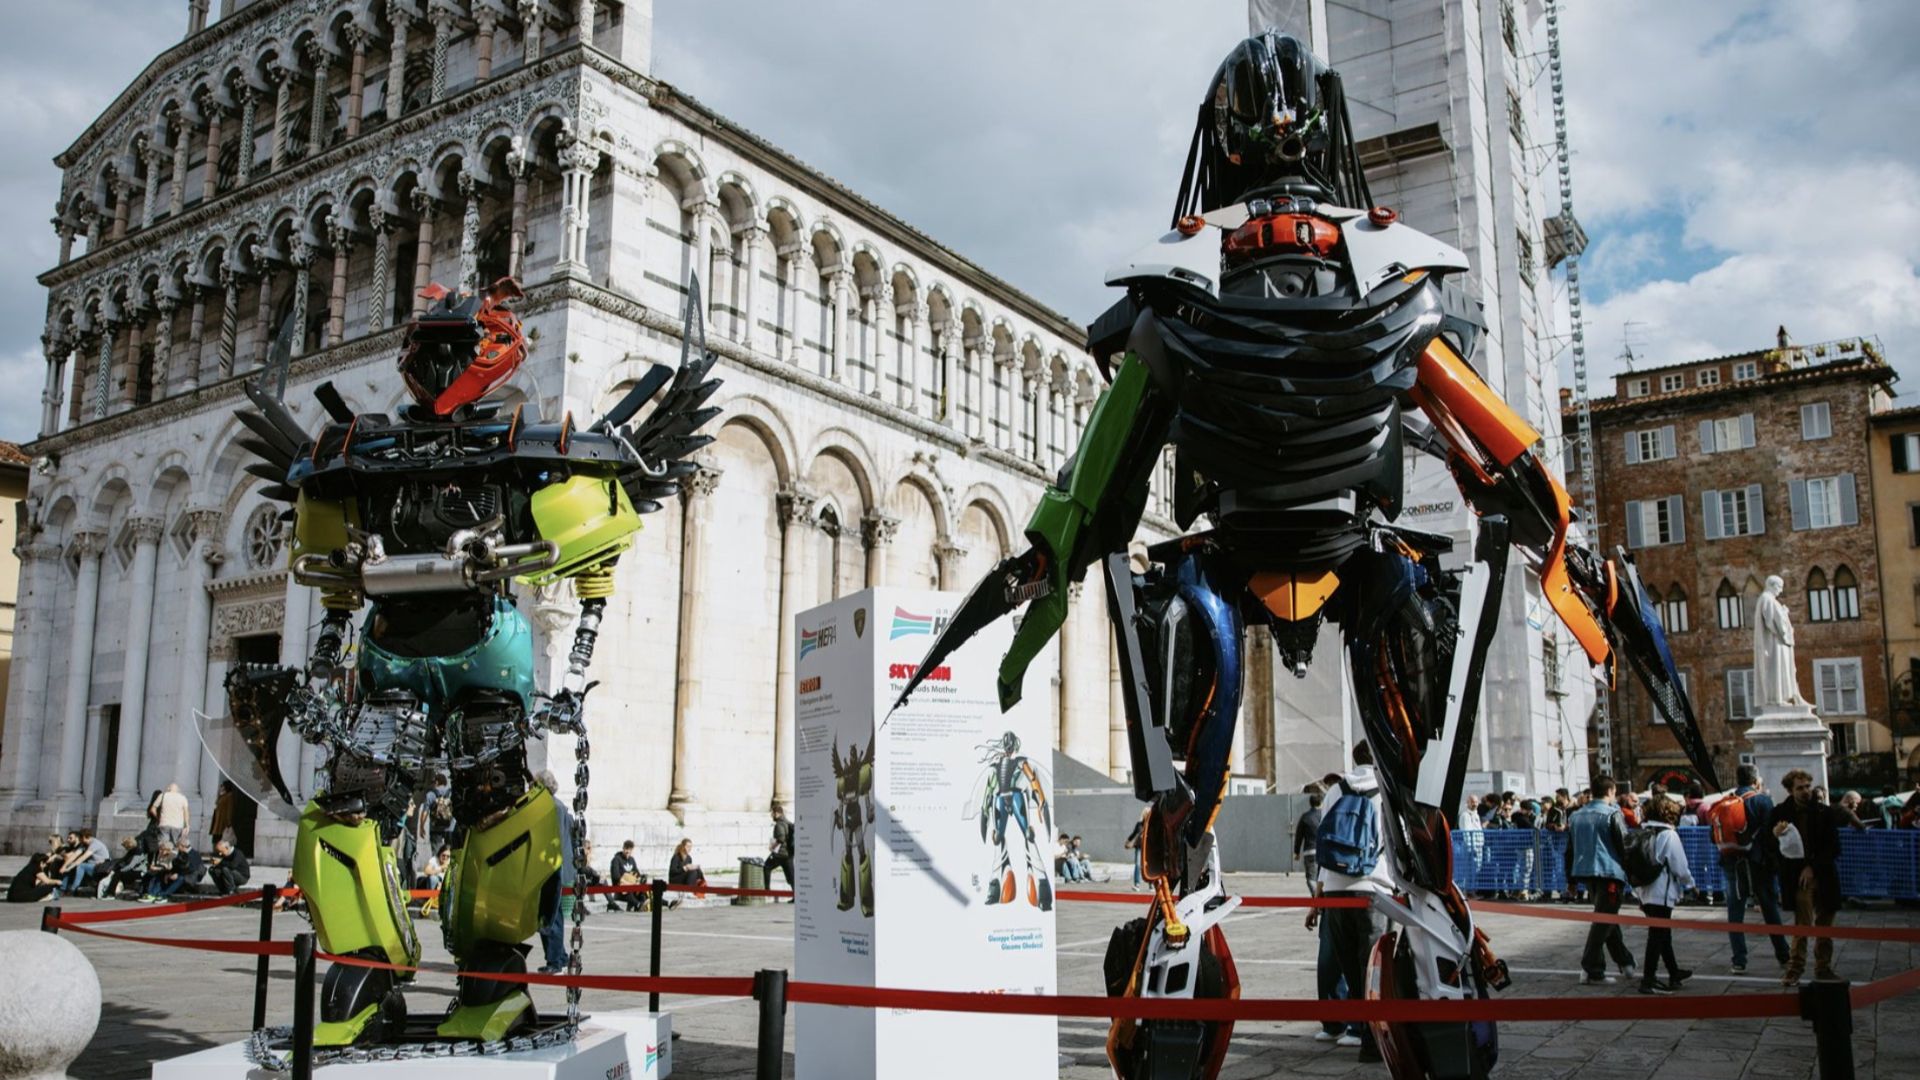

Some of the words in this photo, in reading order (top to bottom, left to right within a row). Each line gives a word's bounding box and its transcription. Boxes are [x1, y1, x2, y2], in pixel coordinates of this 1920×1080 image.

[817, 624, 837, 648] HERA
[890, 683, 904, 692] The
[912, 684, 930, 694] ouds
[931, 685, 957, 695] Mother
